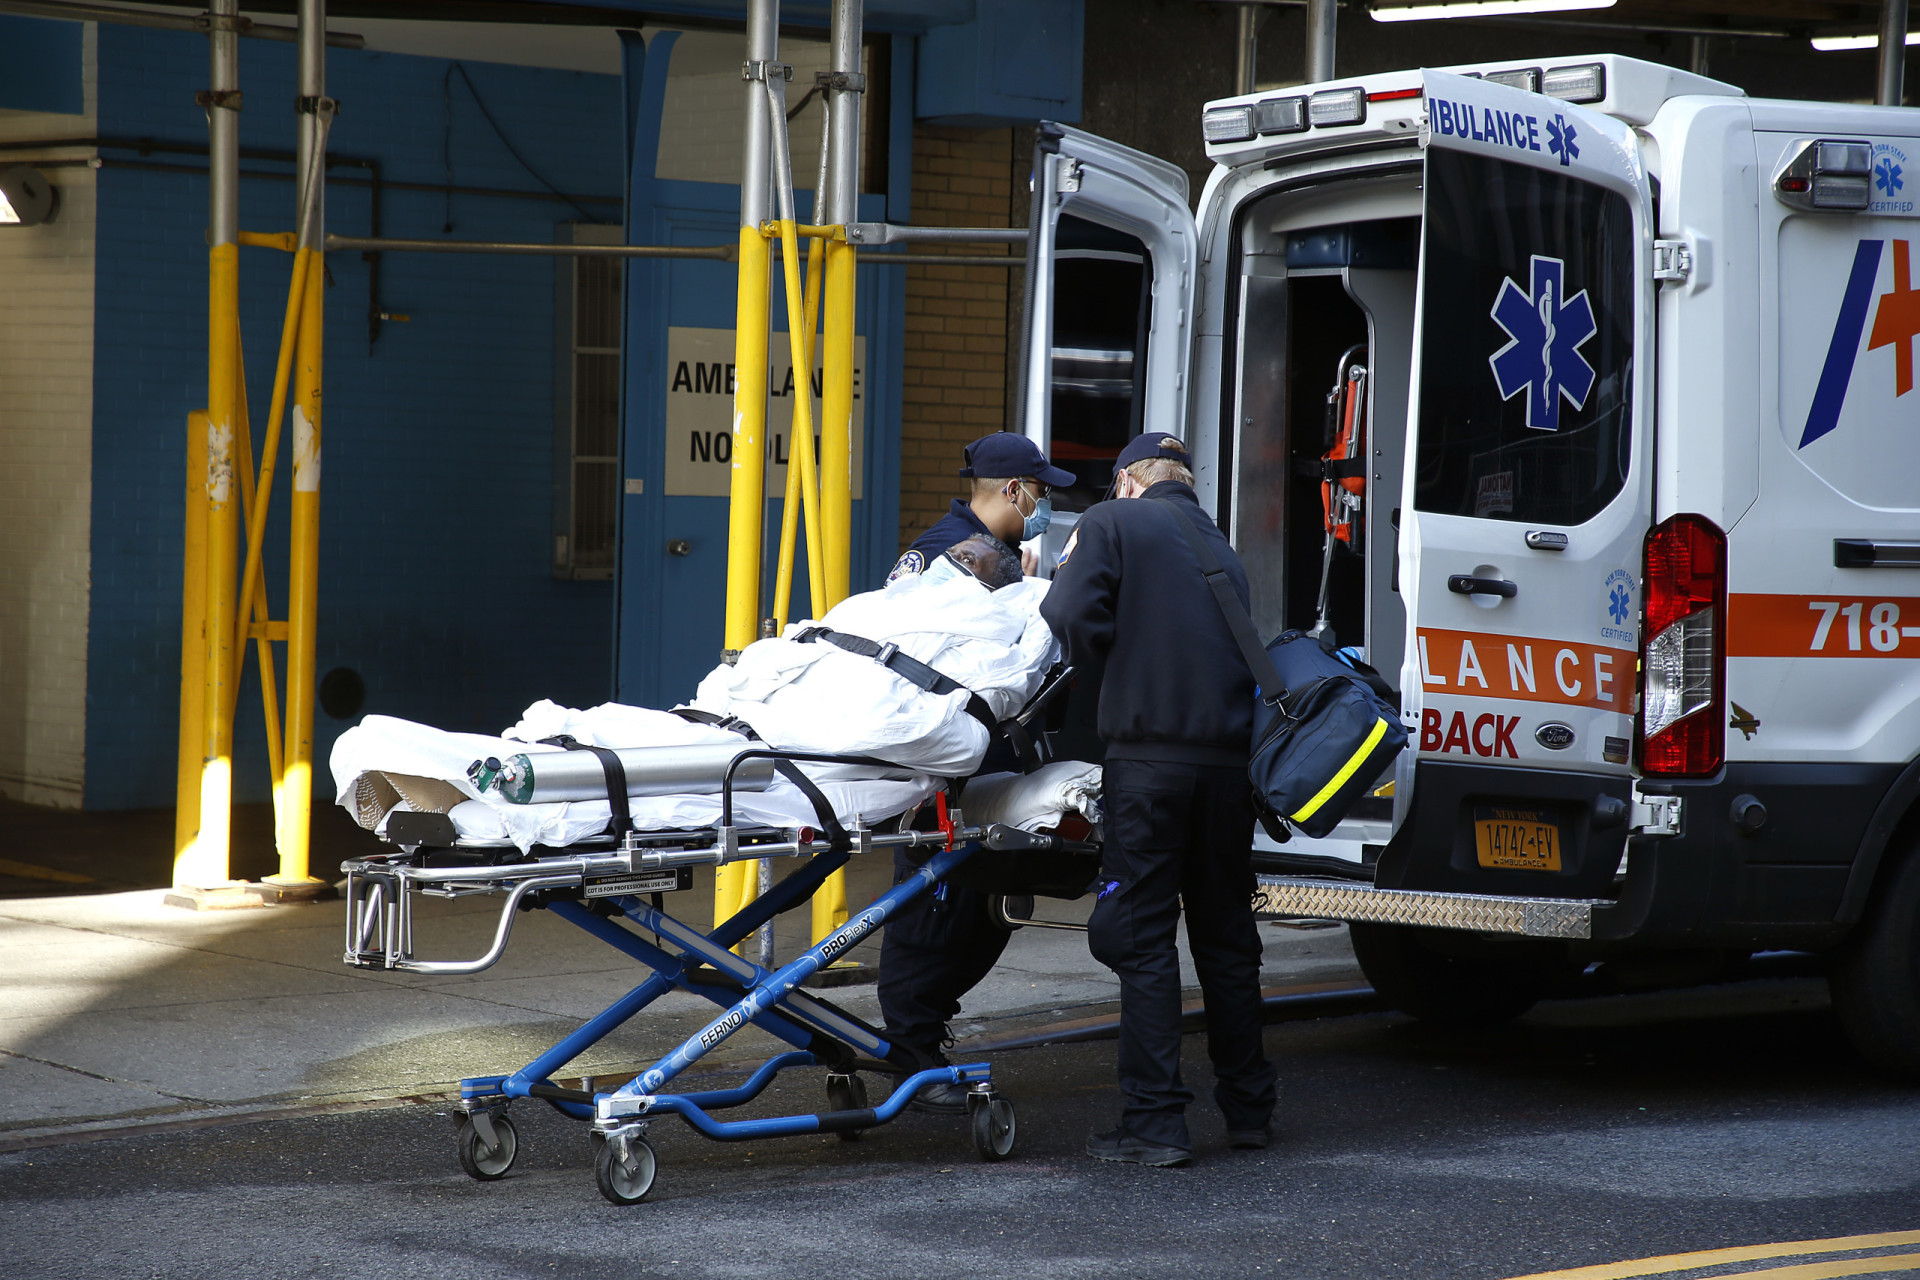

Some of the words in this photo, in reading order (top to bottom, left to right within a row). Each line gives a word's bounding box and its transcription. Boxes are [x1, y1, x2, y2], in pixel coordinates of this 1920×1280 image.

[1869, 201, 1913, 212] CERTIFIED
[672, 361, 860, 399] AMBLAN
[1604, 572, 1614, 587] NEW
[1626, 573, 1636, 592] STATE
[1601, 627, 1634, 643] CERTIFIED
[1419, 708, 1521, 759] BACK
[1546, 728, 1569, 743] Ford
[1495, 809, 1515, 820] NEW
[1516, 811, 1538, 821] YORK
[1499, 857, 1541, 867] AMBULANCE
[614, 883, 650, 891] PROFESSIONAL
[700, 1012, 741, 1049] FERNO
